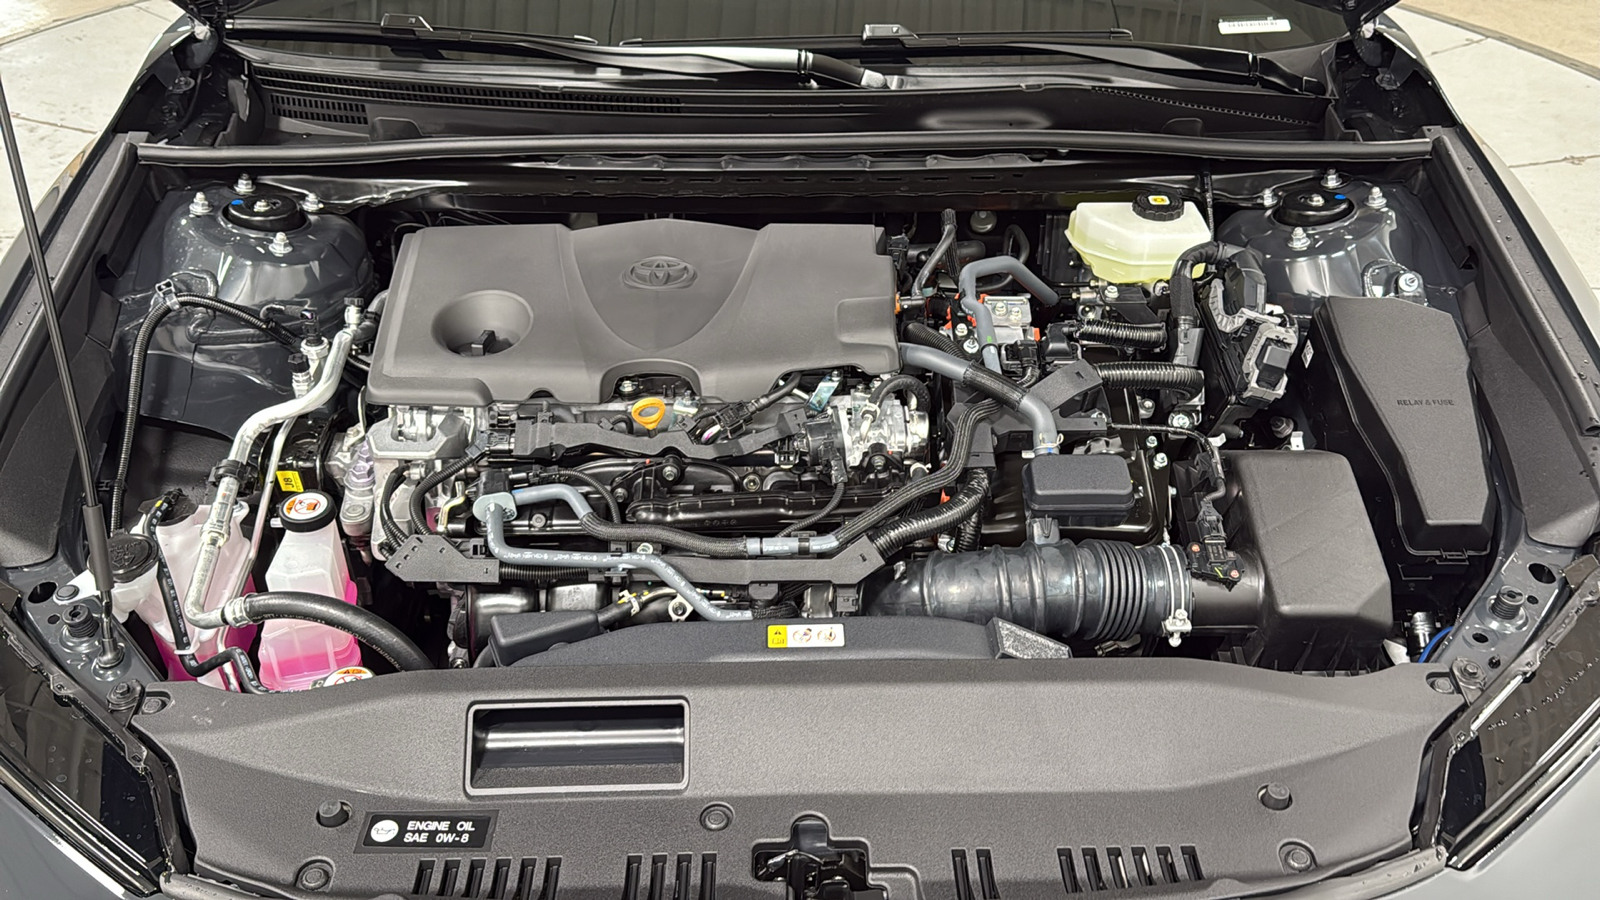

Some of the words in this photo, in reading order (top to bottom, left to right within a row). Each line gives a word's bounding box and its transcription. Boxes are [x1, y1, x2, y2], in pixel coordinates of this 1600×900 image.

[283, 477, 295, 488] J8
[406, 821, 450, 831] ENGINE
[456, 821, 475, 831] OIL
[403, 832, 429, 843] SAE
[435, 833, 470, 843] 0W-8
